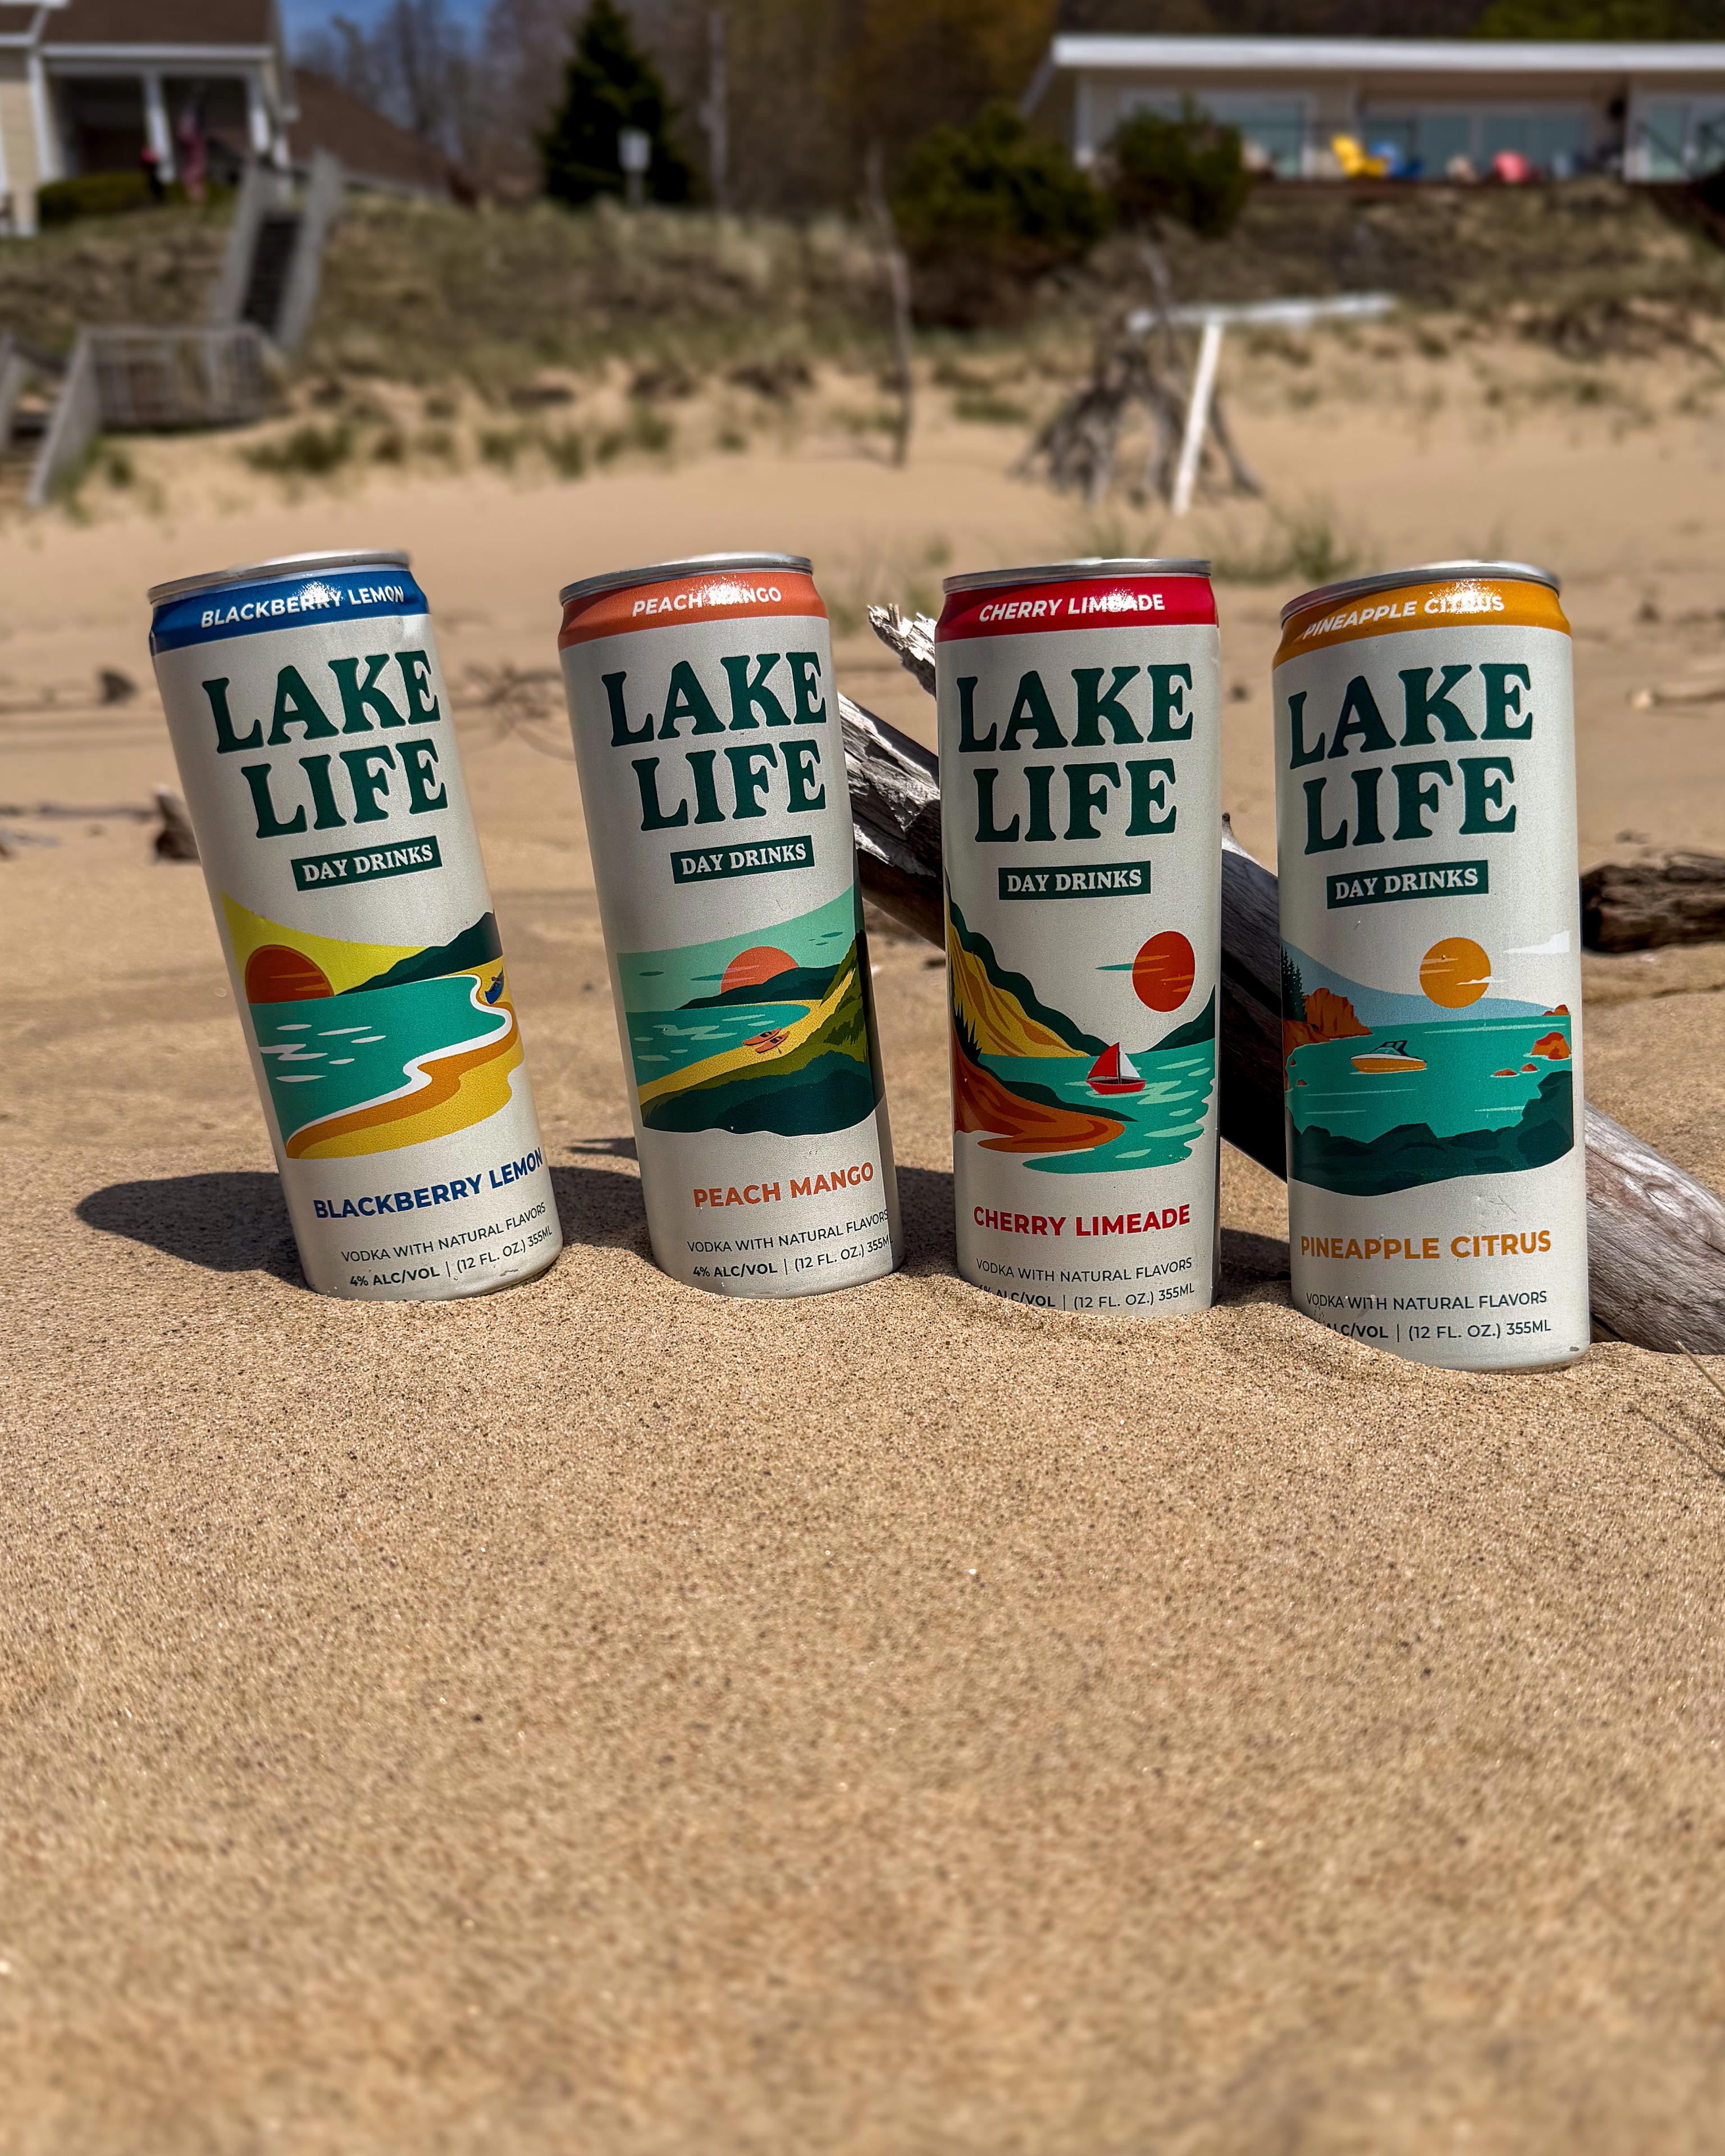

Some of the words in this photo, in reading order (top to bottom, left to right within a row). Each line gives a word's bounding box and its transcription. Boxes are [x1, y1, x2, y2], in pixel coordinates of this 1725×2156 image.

[347, 586, 404, 605] LEMON
[632, 593, 703, 617] PEACH
[707, 587, 782, 606] ANGO
[979, 599, 1062, 623] CHERRY
[1302, 601, 1417, 641] PINEAPPLE
[202, 650, 441, 754] LAKE
[601, 652, 827, 747] LAKE
[956, 663, 1194, 753] LAKE
[1288, 663, 1534, 770] LAKE
[241, 739, 448, 839] LIFE
[631, 739, 826, 831] LIFE
[973, 758, 1177, 843] LIFE
[1302, 757, 1517, 855] LIFE
[302, 861, 348, 883] DAY
[355, 844, 433, 874] DRINKS
[680, 855, 723, 875] DAY
[728, 843, 806, 869] DRINKS
[1007, 874, 1051, 892] DAY
[1055, 869, 1142, 892] DRINKS
[1335, 877, 1377, 900] DAY
[1384, 868, 1479, 893] DRINKS
[313, 1173, 482, 1219] BLACKBERRY
[489, 1146, 543, 1189] LEMON
[692, 1181, 781, 1208] PEACH
[790, 1162, 874, 1199] MANGO
[341, 1248, 391, 1263] VODKA
[394, 1241, 434, 1258] WITH
[438, 1223, 504, 1249] NATURAL
[505, 1202, 546, 1230] FLAVORS
[687, 1240, 732, 1253] VODKA
[735, 1236, 774, 1251] WITH
[778, 1225, 843, 1247] NATURAL
[846, 1209, 889, 1234] FLAVORS
[973, 1205, 1067, 1236] CHERRY
[1075, 1204, 1190, 1236] LIMEADE
[350, 1275, 368, 1287] 4%
[373, 1265, 440, 1286] ALC/VOL
[457, 1257, 476, 1274] (12
[480, 1251, 500, 1268] FL.
[503, 1239, 526, 1258] OZ.)
[527, 1227, 553, 1248] 355ML
[693, 1265, 710, 1278] 4%
[714, 1262, 778, 1278] ALC/VOL
[795, 1257, 814, 1273] (12
[817, 1251, 837, 1266] FL.
[841, 1244, 865, 1260] OZ.)
[867, 1233, 893, 1253] 355ML
[1300, 1235, 1440, 1260] PINEAPPLE
[1450, 1230, 1551, 1258] CITRUS
[976, 1258, 1015, 1278] VODKA
[1017, 1267, 1055, 1282] WITH
[1060, 1269, 1131, 1282] NATURAL
[1135, 1257, 1193, 1279] FLAVORS
[1074, 1296, 1093, 1310] (12
[1099, 1295, 1121, 1309] FL.
[1125, 1290, 1154, 1307] OZ.)
[1158, 1282, 1195, 1302] 355ML
[1306, 1292, 1344, 1309] VODKA
[1347, 1297, 1387, 1310] WITH
[1393, 1296, 1475, 1311] NATURAL
[1478, 1290, 1548, 1309] FLAVORS
[1409, 1325, 1430, 1341] (12
[1436, 1325, 1462, 1340] FL.
[1467, 1323, 1501, 1339] OZ.)
[1506, 1319, 1551, 1336] 355ML
